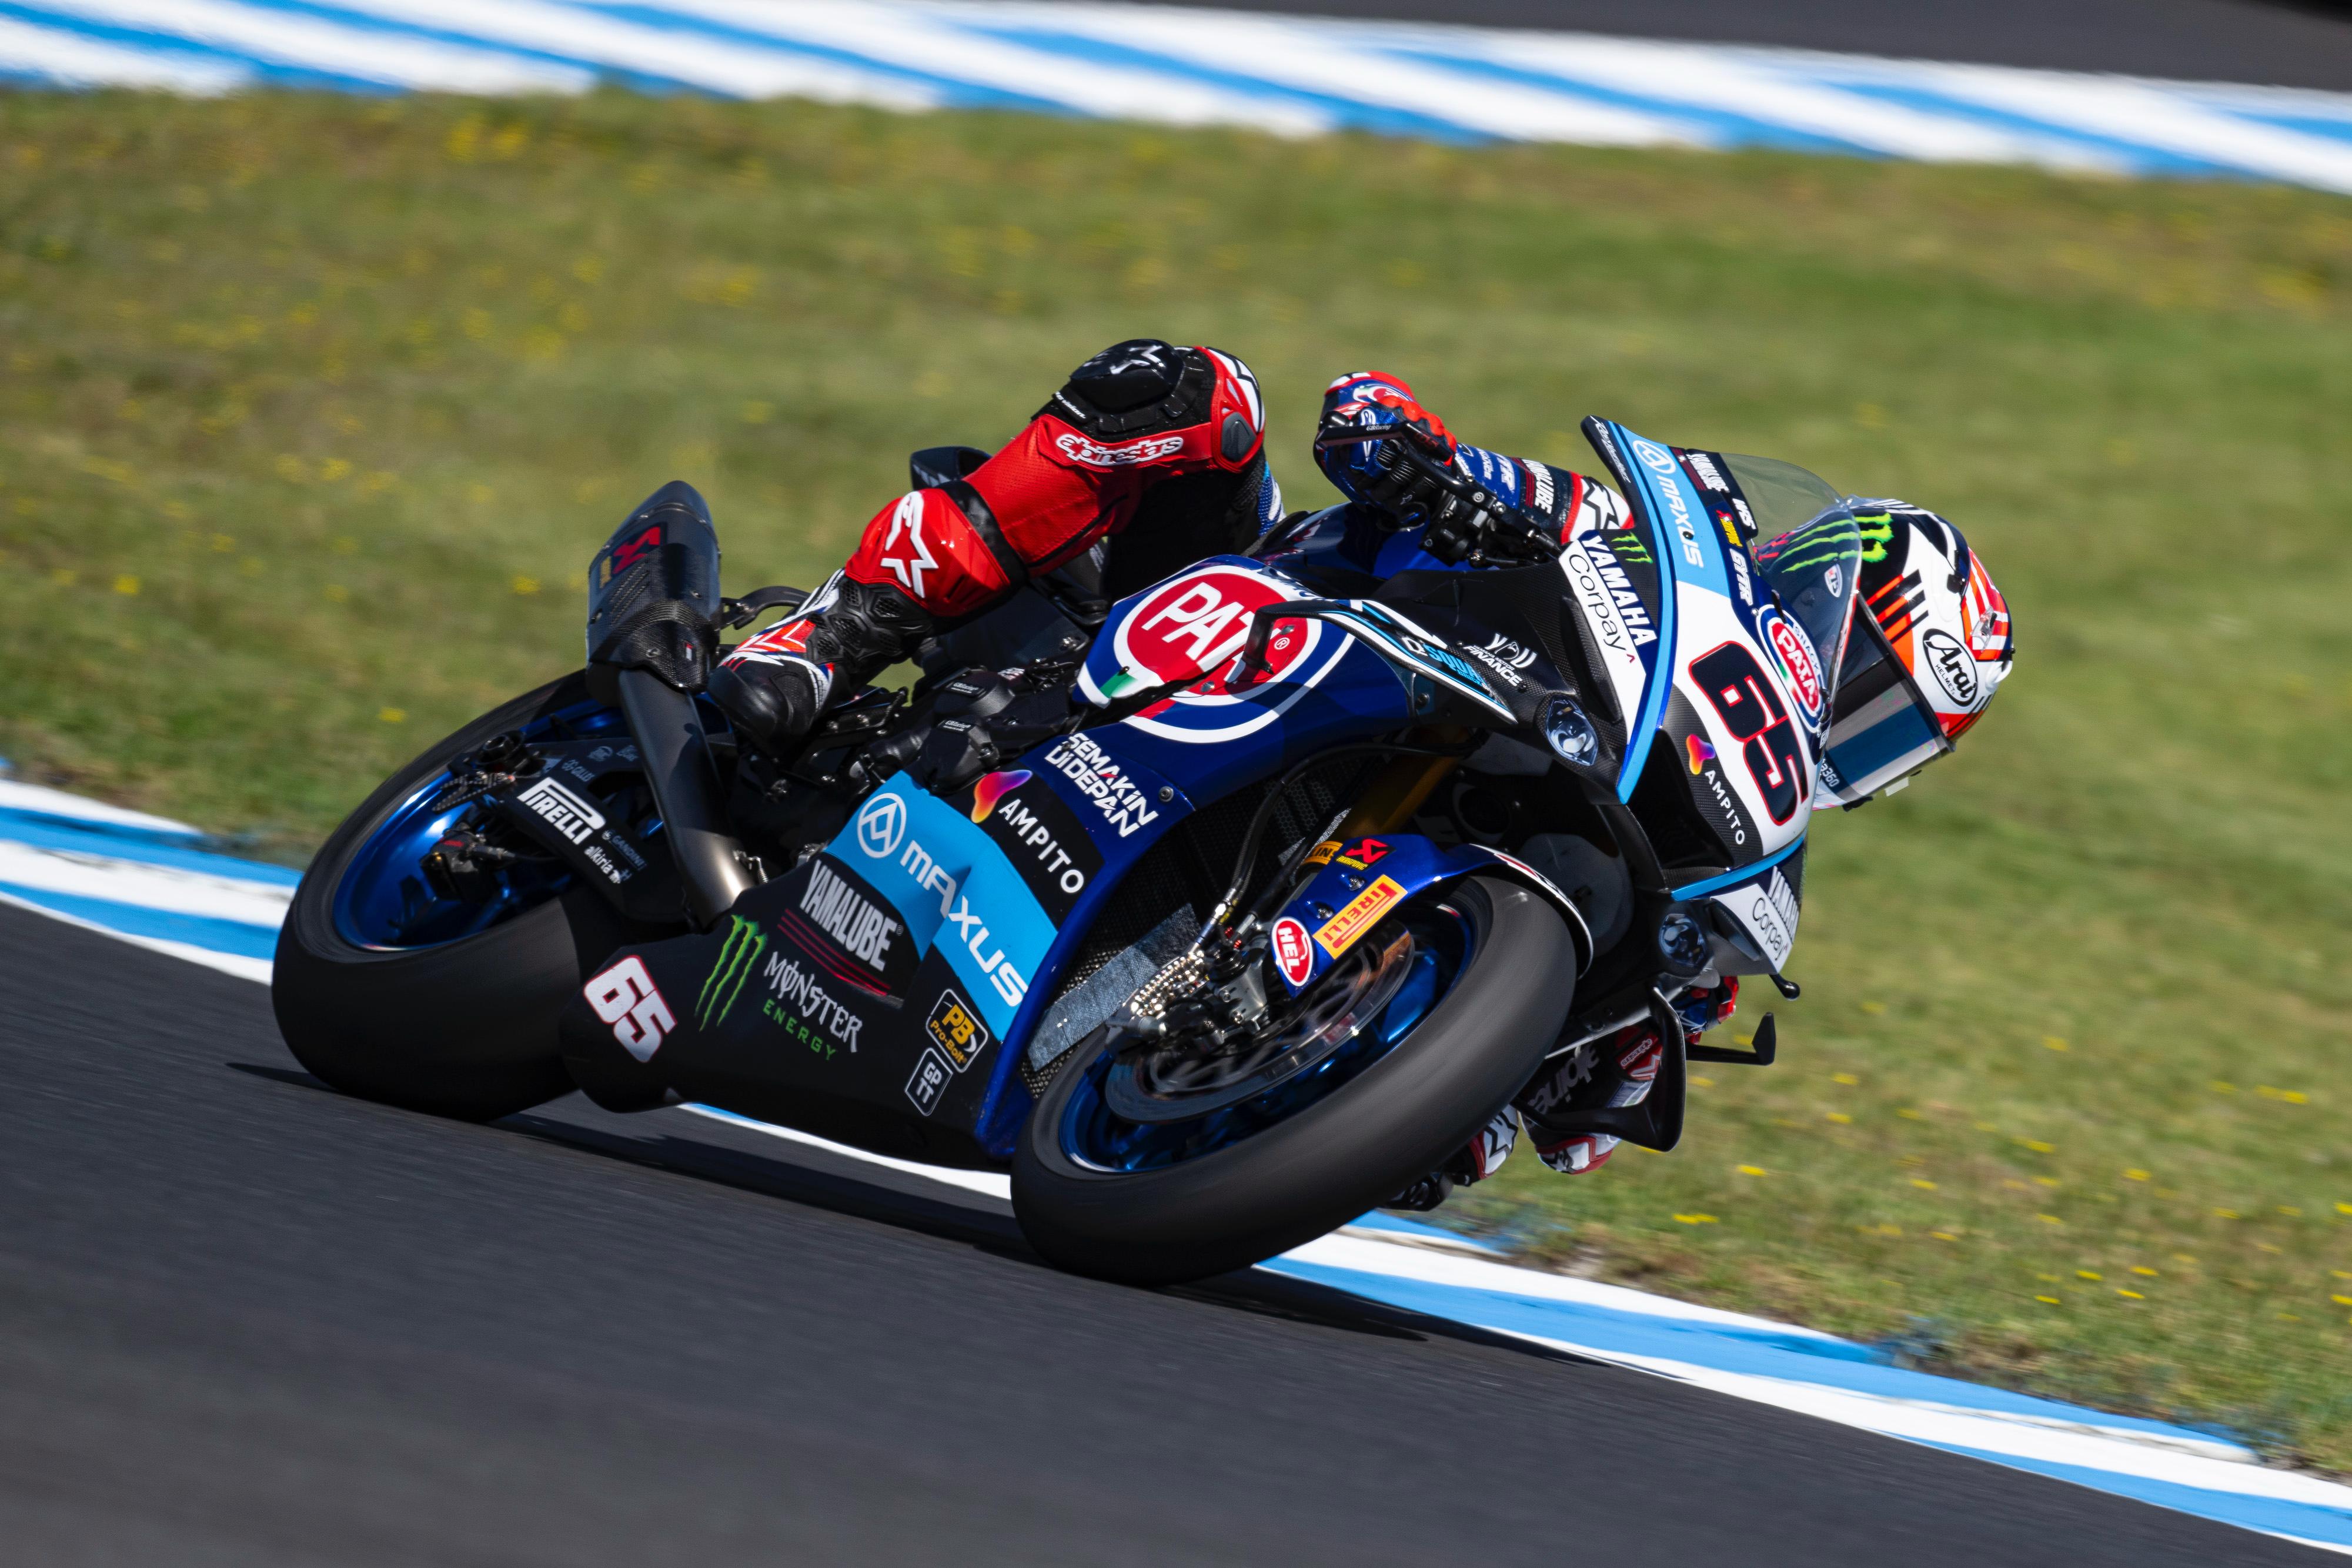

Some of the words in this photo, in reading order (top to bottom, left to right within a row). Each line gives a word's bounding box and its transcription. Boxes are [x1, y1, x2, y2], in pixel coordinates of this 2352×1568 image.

[1568, 554, 1627, 651] Corpay
[1581, 534, 1658, 646] YAMAHA
[1462, 645, 1524, 687] FINANCE
[1776, 627, 1816, 704] PATA
[1924, 640, 1977, 698] Arai
[1688, 640, 1809, 826] 65
[516, 776, 606, 845] PIRELLI
[1704, 769, 1745, 845] AMPITO
[998, 798, 1084, 894] AMPITO
[800, 858, 898, 972] YAMALUBE
[900, 839, 1028, 1007] MAXUS
[1323, 882, 1398, 949] PIRELLI
[1752, 897, 1784, 961] Corpay
[1277, 927, 1300, 974] HEL
[583, 954, 678, 1064] 65
[763, 998, 837, 1061] ENERGY
[941, 1004, 975, 1045] PB
[916, 1077, 934, 1104] TT
[923, 1061, 943, 1085] GP
